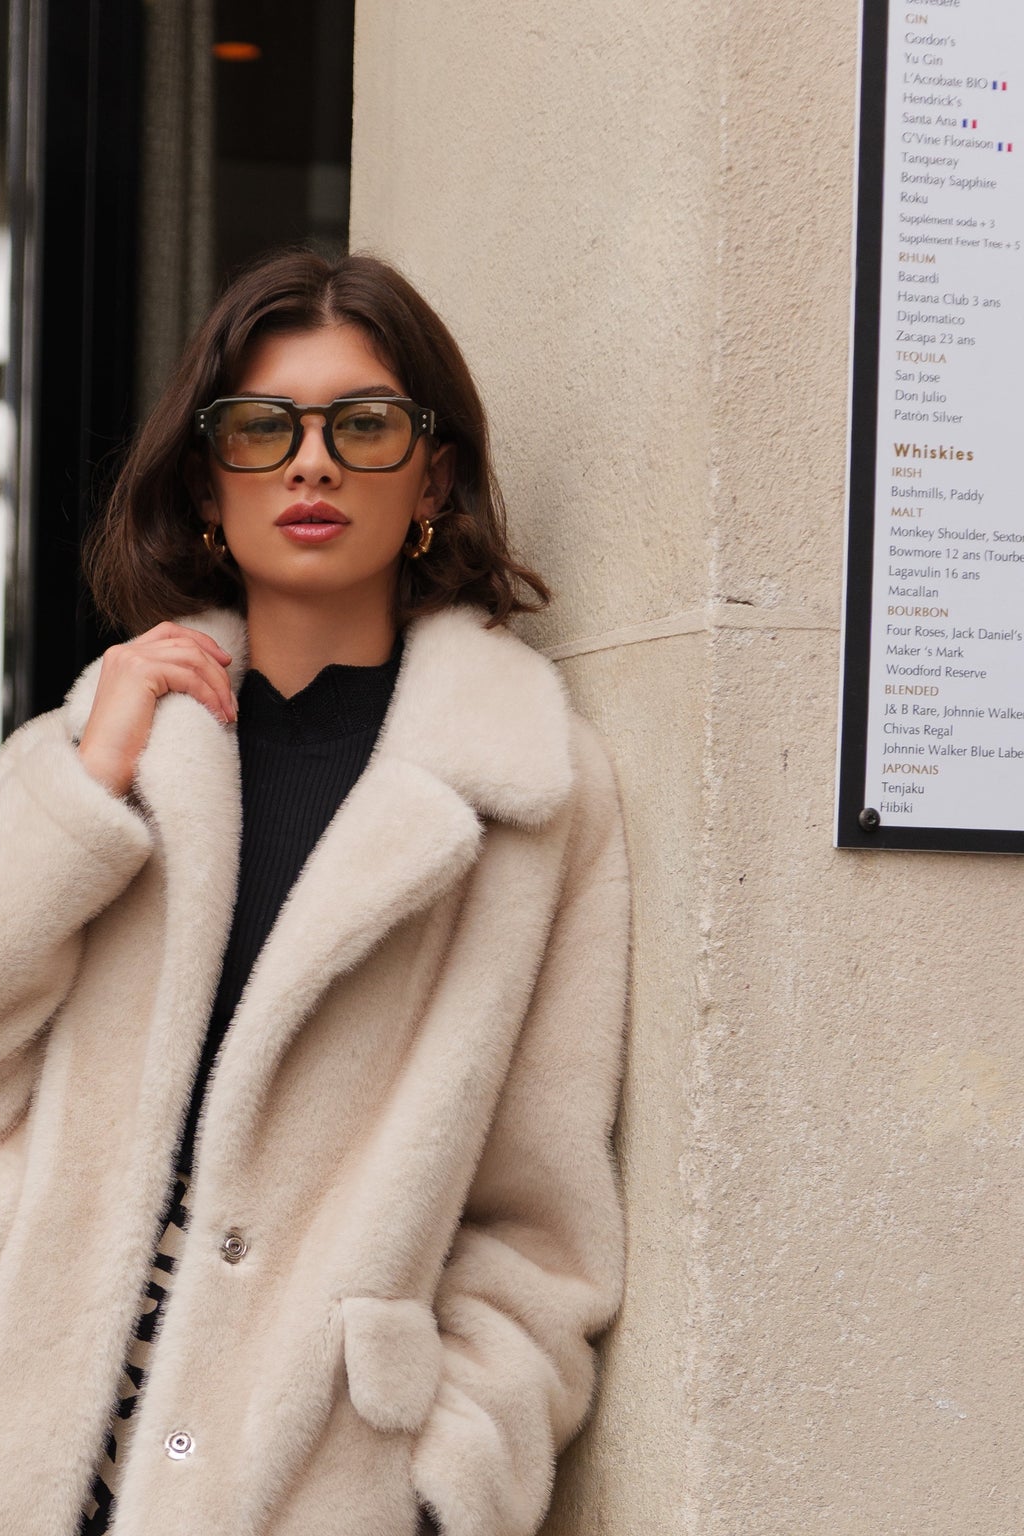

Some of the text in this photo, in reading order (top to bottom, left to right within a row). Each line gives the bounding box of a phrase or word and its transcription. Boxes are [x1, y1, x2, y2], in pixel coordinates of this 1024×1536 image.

[905, 13, 928, 24] GIN
[905, 32, 956, 47] Gordon's
[923, 54, 943, 66] Gin
[903, 72, 988, 89] L'Acrobate BIO
[903, 92, 962, 107] Hendrick's
[902, 112, 957, 127] Santa Ana
[944, 134, 994, 149] Floraison
[901, 152, 959, 169] Tanqueray
[901, 172, 997, 190] Bombay Sapphire
[900, 192, 929, 204] Roku
[899, 212, 954, 225] Supplément
[956, 216, 978, 227] soda
[989, 220, 996, 229] 3
[899, 233, 954, 246] Supplément
[956, 236, 981, 247] Fever
[984, 238, 1003, 249] Tree
[1016, 241, 1022, 250] 5
[898, 252, 937, 264] RHUM
[898, 271, 940, 284] Bacardi
[897, 291, 1002, 308] Havana Club 3 ans
[897, 311, 966, 326] Diplomatico
[896, 330, 976, 346] Zacapa 23 ans
[896, 351, 947, 364] TEQUILA
[895, 370, 941, 384] San Jose
[895, 390, 947, 403] Don Julio
[933, 411, 964, 424] Silver
[893, 442, 975, 461] Whiskies
[891, 467, 922, 478] IRISH
[891, 486, 985, 504] Bushmills, Paddy
[890, 507, 924, 518] MALT
[890, 526, 935, 542] Monkey
[937, 528, 990, 543] Shoulder,
[889, 545, 1024, 563] Bowmore 12 ans (Tourbe
[888, 565, 981, 580] Lagavulin 16 ans
[888, 585, 939, 598] Macallan
[887, 605, 949, 618] BOURBON
[887, 624, 1023, 641] Four Roses, Jack Daniel's
[886, 644, 921, 656] Maker
[936, 647, 965, 658] Mark
[886, 664, 987, 679] Woodford Reserve
[885, 684, 939, 697] BLENDED
[901, 703, 909, 715] B
[912, 704, 940, 718] Rare,
[943, 705, 985, 719] Johnnie
[883, 722, 954, 740] Chivas Regal
[883, 743, 925, 756] Johnnie
[928, 744, 968, 757] Walker
[971, 745, 995, 758] Blue
[882, 763, 939, 776] JAPONAIS
[881, 781, 925, 797] Tenjaku
[880, 801, 913, 814] Hibiki
